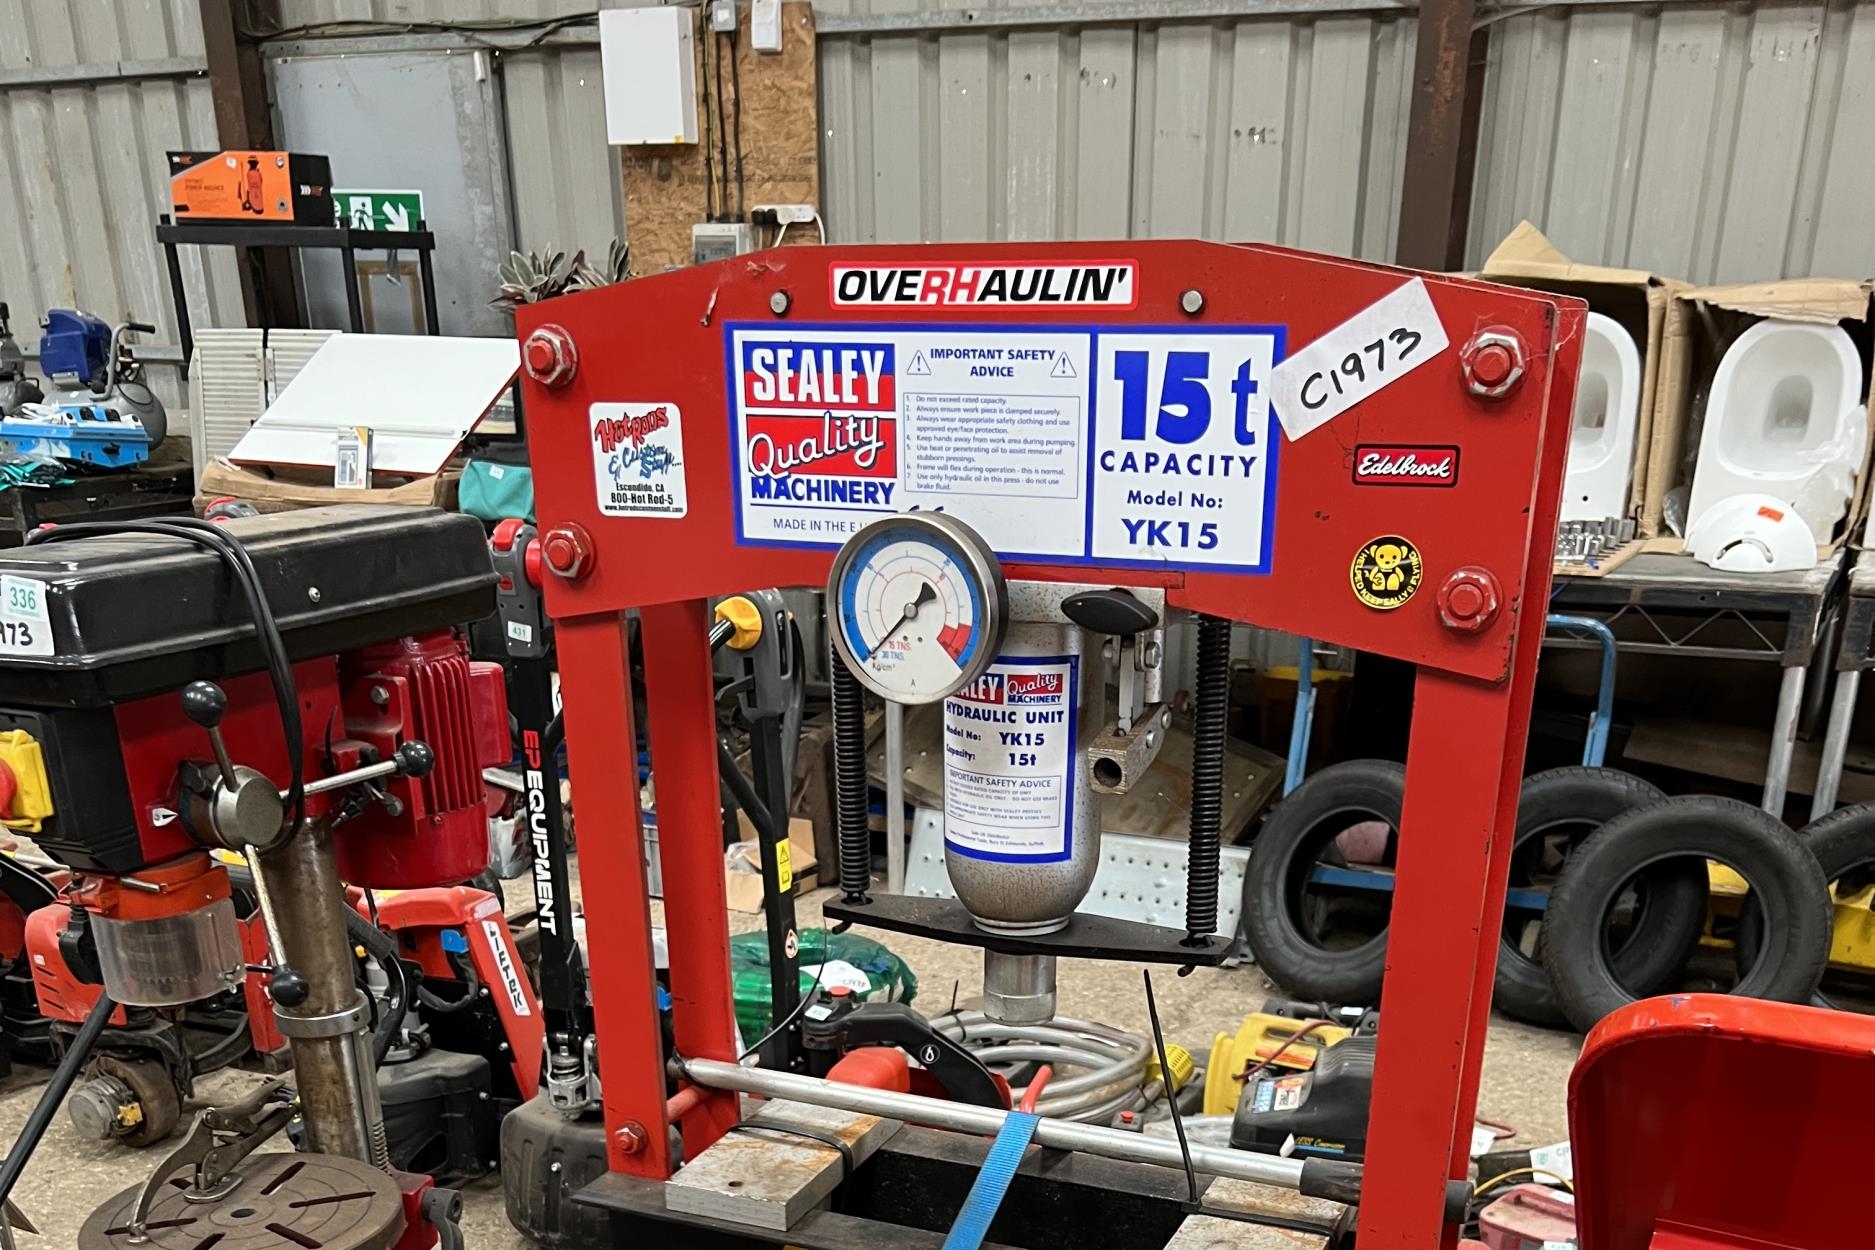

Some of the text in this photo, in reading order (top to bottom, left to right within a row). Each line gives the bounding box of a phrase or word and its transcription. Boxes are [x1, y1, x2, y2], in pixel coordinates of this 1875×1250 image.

[838, 268, 1128, 303] OVERHAULIN'
[930, 348, 1055, 361] IMPORTANT SAFETY
[752, 348, 885, 405] SEALEY
[970, 366, 1014, 378] ADVICE
[1301, 327, 1421, 409] C1973
[748, 411, 885, 479] Quality
[1100, 451, 1258, 478] CAPACITY
[1357, 453, 1450, 479] Edelbrock
[655, 484, 664, 492] CA
[751, 477, 896, 505] MACHINERY
[1127, 490, 1223, 508] Model No:
[773, 518, 806, 531] MADE
[810, 519, 821, 531] IN
[824, 520, 847, 532] THE
[1121, 518, 1219, 549] YK15
[1355, 552, 1367, 589] HELPED
[1409, 551, 1420, 585] FLYING
[10, 587, 36, 610] 336
[1360, 589, 1383, 605] KEEP
[1384, 591, 1408, 605] SALLY
[1008, 673, 1057, 696] Quality
[1008, 695, 1061, 703] MACHINERY
[947, 701, 1064, 724] HYDRAULIC UNIT
[946, 725, 1044, 746] Model No: YK15
[1009, 753, 1036, 766] 15t
[986, 778, 1016, 788] SAFETY
[1020, 780, 1051, 788] ADVICE
[523, 730, 556, 936] EP EQUIPMENT
